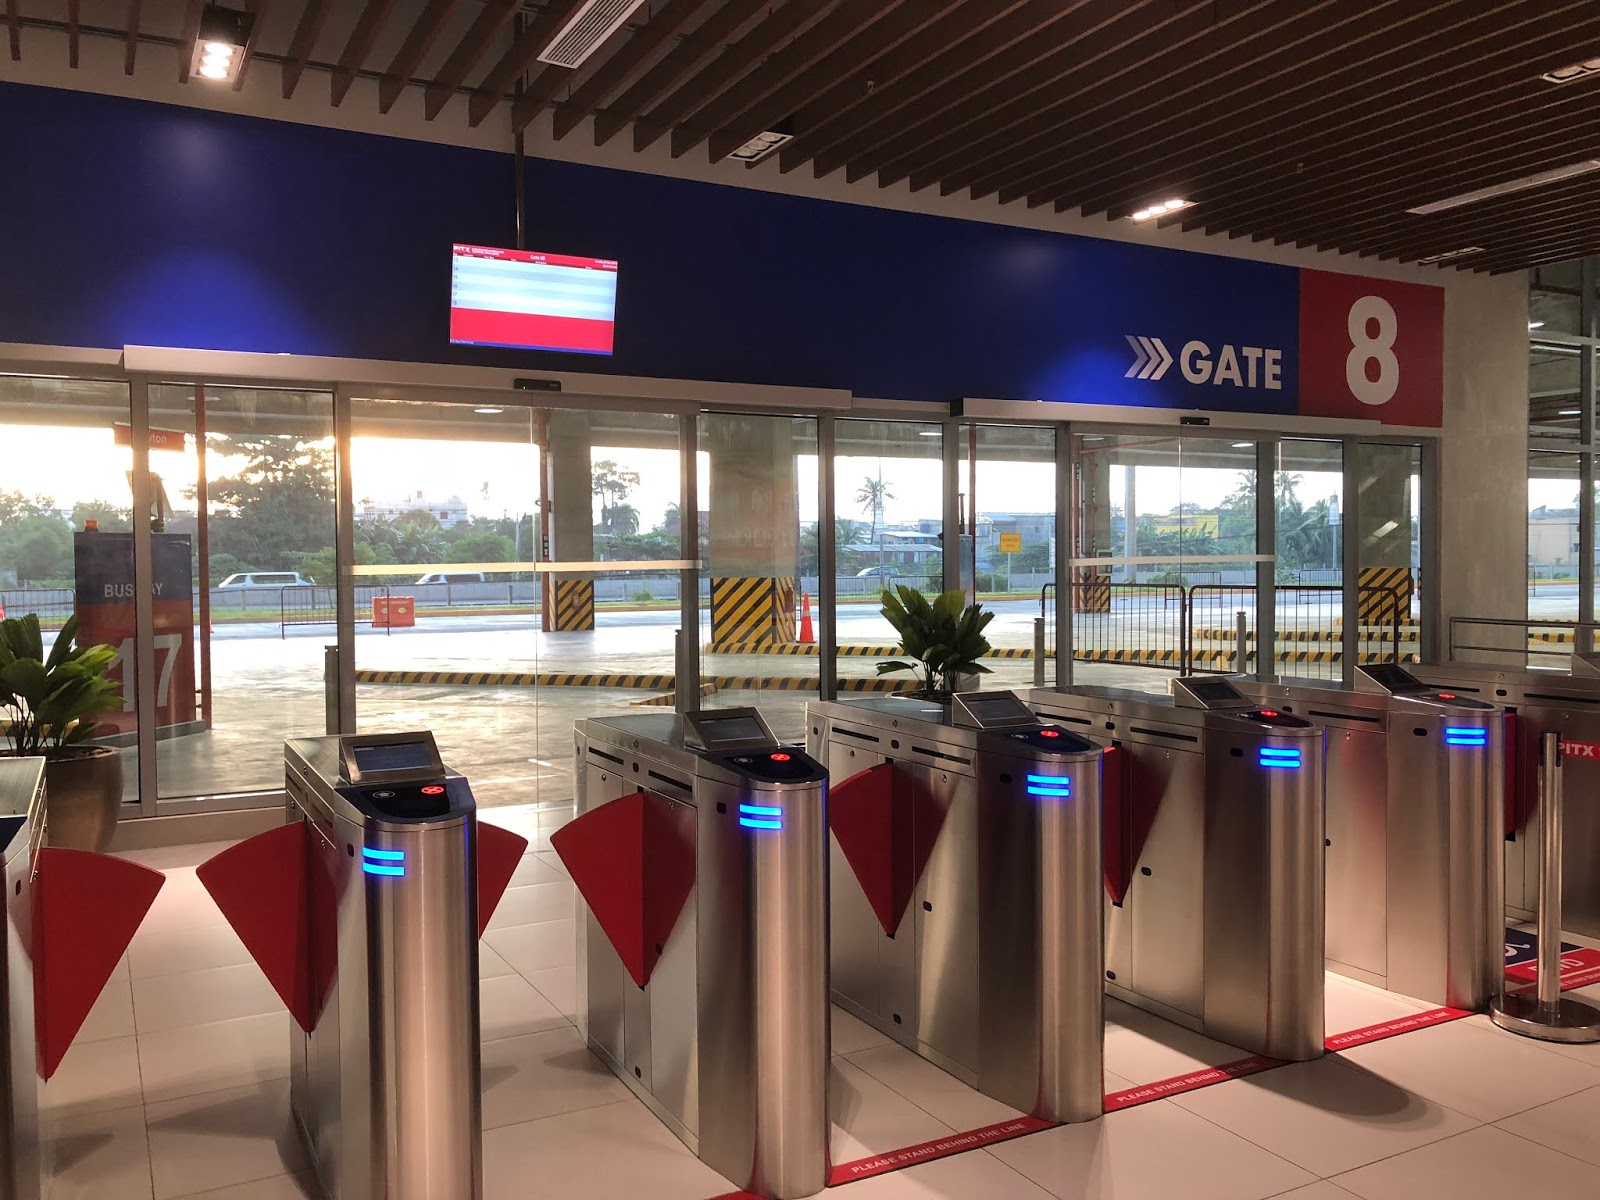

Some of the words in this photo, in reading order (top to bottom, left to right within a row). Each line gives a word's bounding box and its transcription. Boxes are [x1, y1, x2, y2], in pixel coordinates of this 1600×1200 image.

[1179, 339, 1282, 390] GATE
[1345, 295, 1400, 406] 8
[103, 583, 134, 598] BUS
[108, 632, 183, 712] 17
[1116, 1089, 1156, 1103] PLEASE
[1154, 1080, 1186, 1093] STAND
[1185, 1072, 1220, 1085] BEHIND
[850, 1156, 898, 1174] PLEASE
[898, 1147, 936, 1160] STAND
[936, 1135, 978, 1151] BEHIND
[977, 1129, 1001, 1139] THE
[1000, 1122, 1026, 1133] LINE
